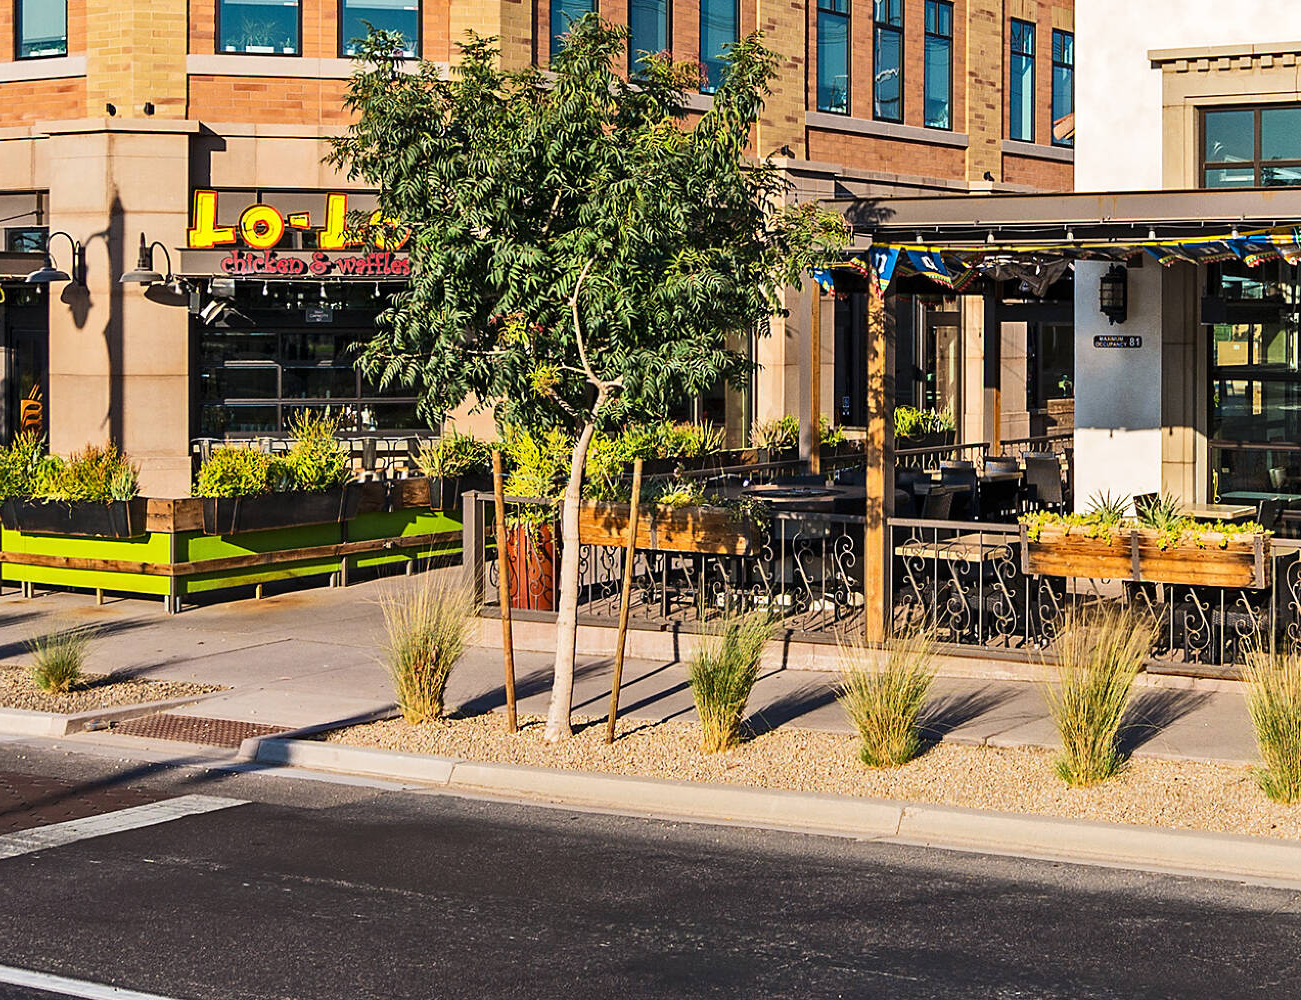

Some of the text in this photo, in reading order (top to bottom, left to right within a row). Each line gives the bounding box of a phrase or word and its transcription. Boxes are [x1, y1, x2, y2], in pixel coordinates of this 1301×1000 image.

[220, 249, 412, 275] chicken & waffles
